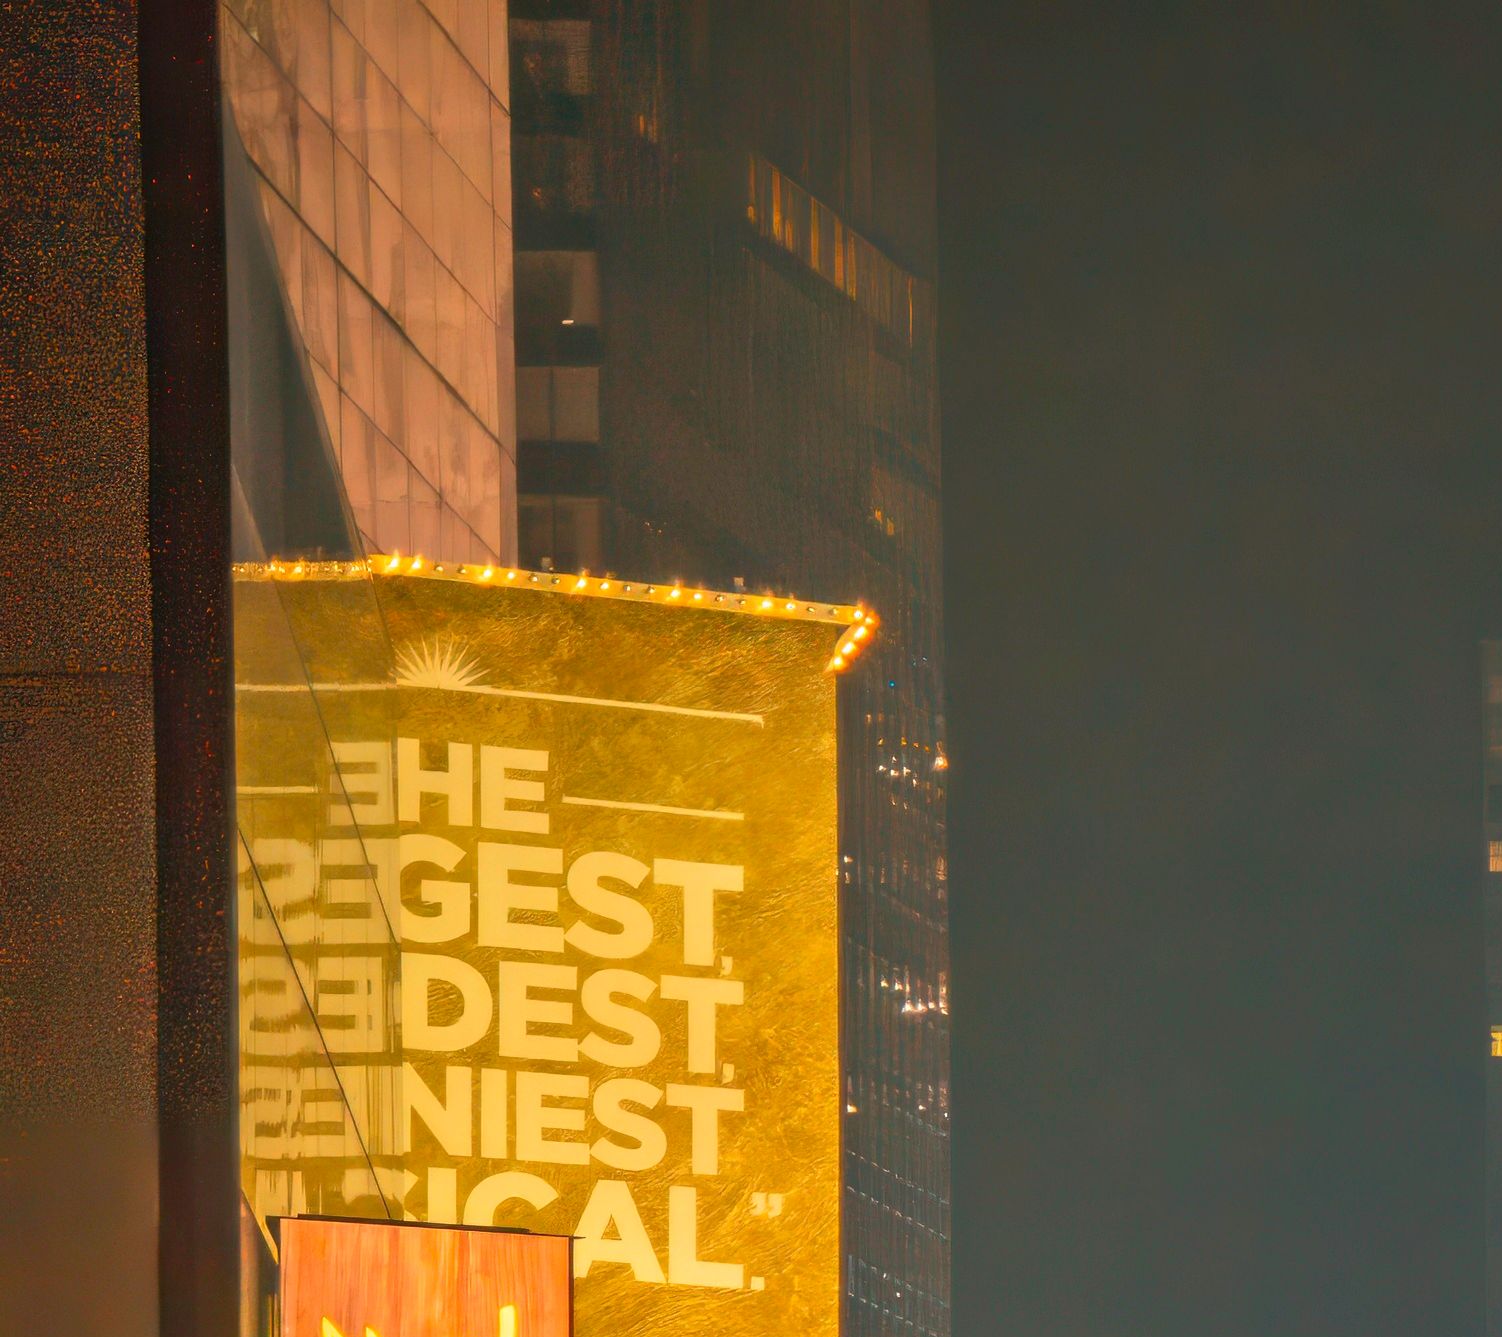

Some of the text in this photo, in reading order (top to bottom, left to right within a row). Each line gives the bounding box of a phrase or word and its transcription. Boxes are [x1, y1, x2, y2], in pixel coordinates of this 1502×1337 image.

[400, 738, 549, 834] HE
[397, 836, 744, 974] GEST,
[400, 952, 744, 1078] DEST,
[400, 1064, 744, 1176] NIEST
